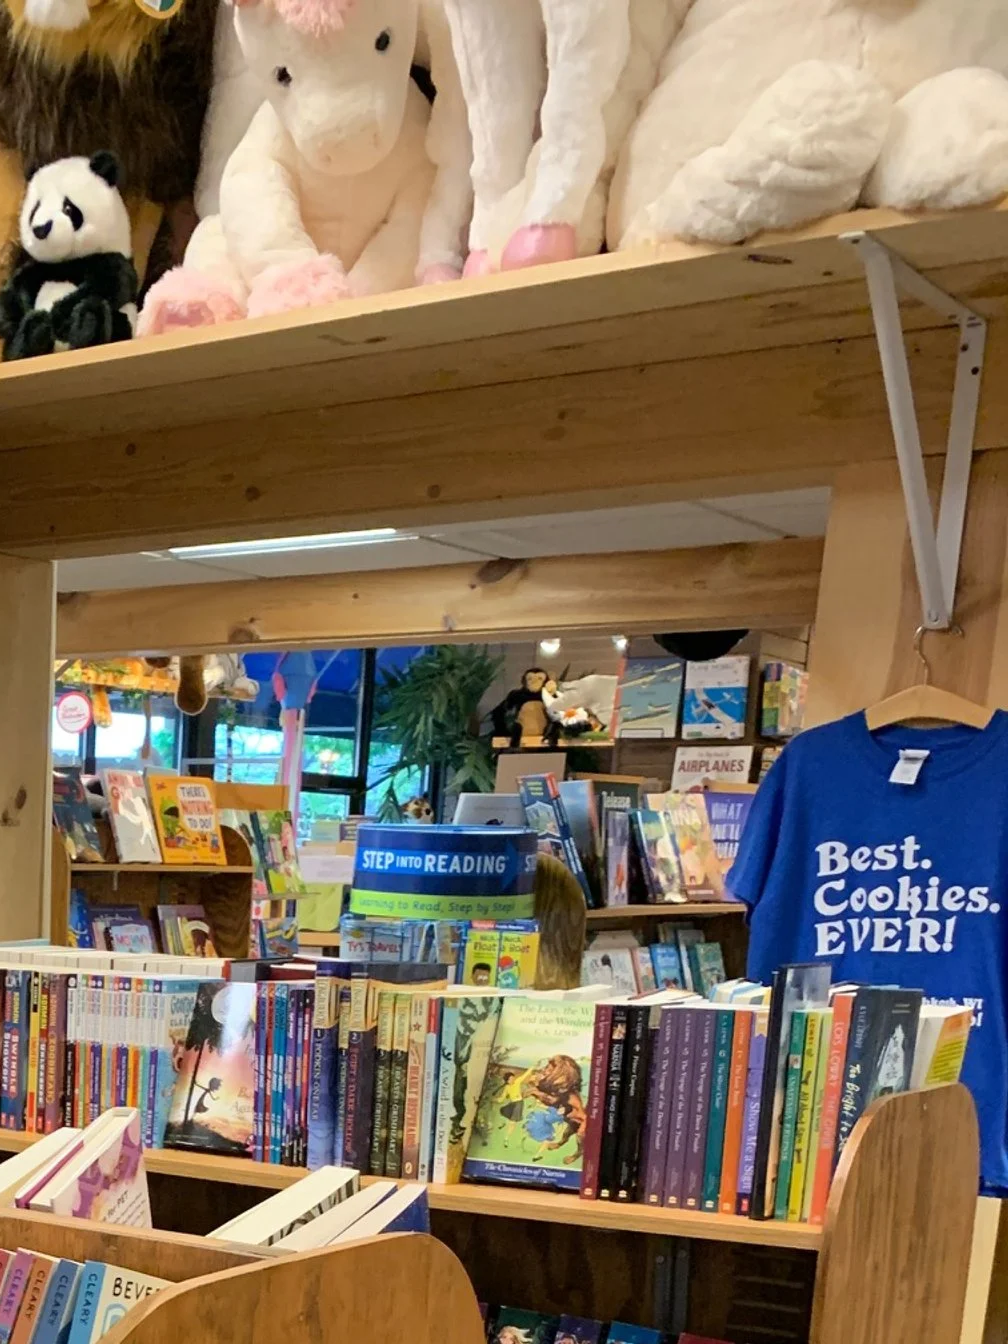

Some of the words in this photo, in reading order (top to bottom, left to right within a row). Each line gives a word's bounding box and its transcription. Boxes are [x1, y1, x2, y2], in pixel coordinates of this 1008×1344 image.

[678, 759, 744, 773] AIRPLANES
[362, 850, 395, 870] STEP
[396, 856, 423, 869] INTO
[424, 853, 507, 874] READING
[814, 835, 932, 877] Best.
[448, 900, 473, 915] Step
[476, 901, 491, 915] by
[813, 876, 1002, 919] Cookies.
[814, 916, 957, 957] EVER!
[834, 1022, 844, 1045] LOIS
[2, 1031, 10, 1092] SHOWOFF
[10, 1033, 19, 1095] SWINDLE
[610, 1044, 619, 1071] NARNIA
[828, 1049, 844, 1087] LOWRY
[849, 1063, 862, 1078] Too
[442, 1077, 451, 1100] Wind
[841, 1082, 859, 1116] Bright
[748, 1101, 760, 1132] Show
[745, 1135, 757, 1154] Me
[740, 1164, 754, 1189] Sign
[24, 1268, 46, 1319] CLEARY
[47, 1275, 69, 1326] CLEARY
[79, 1272, 98, 1325] CLEARY
